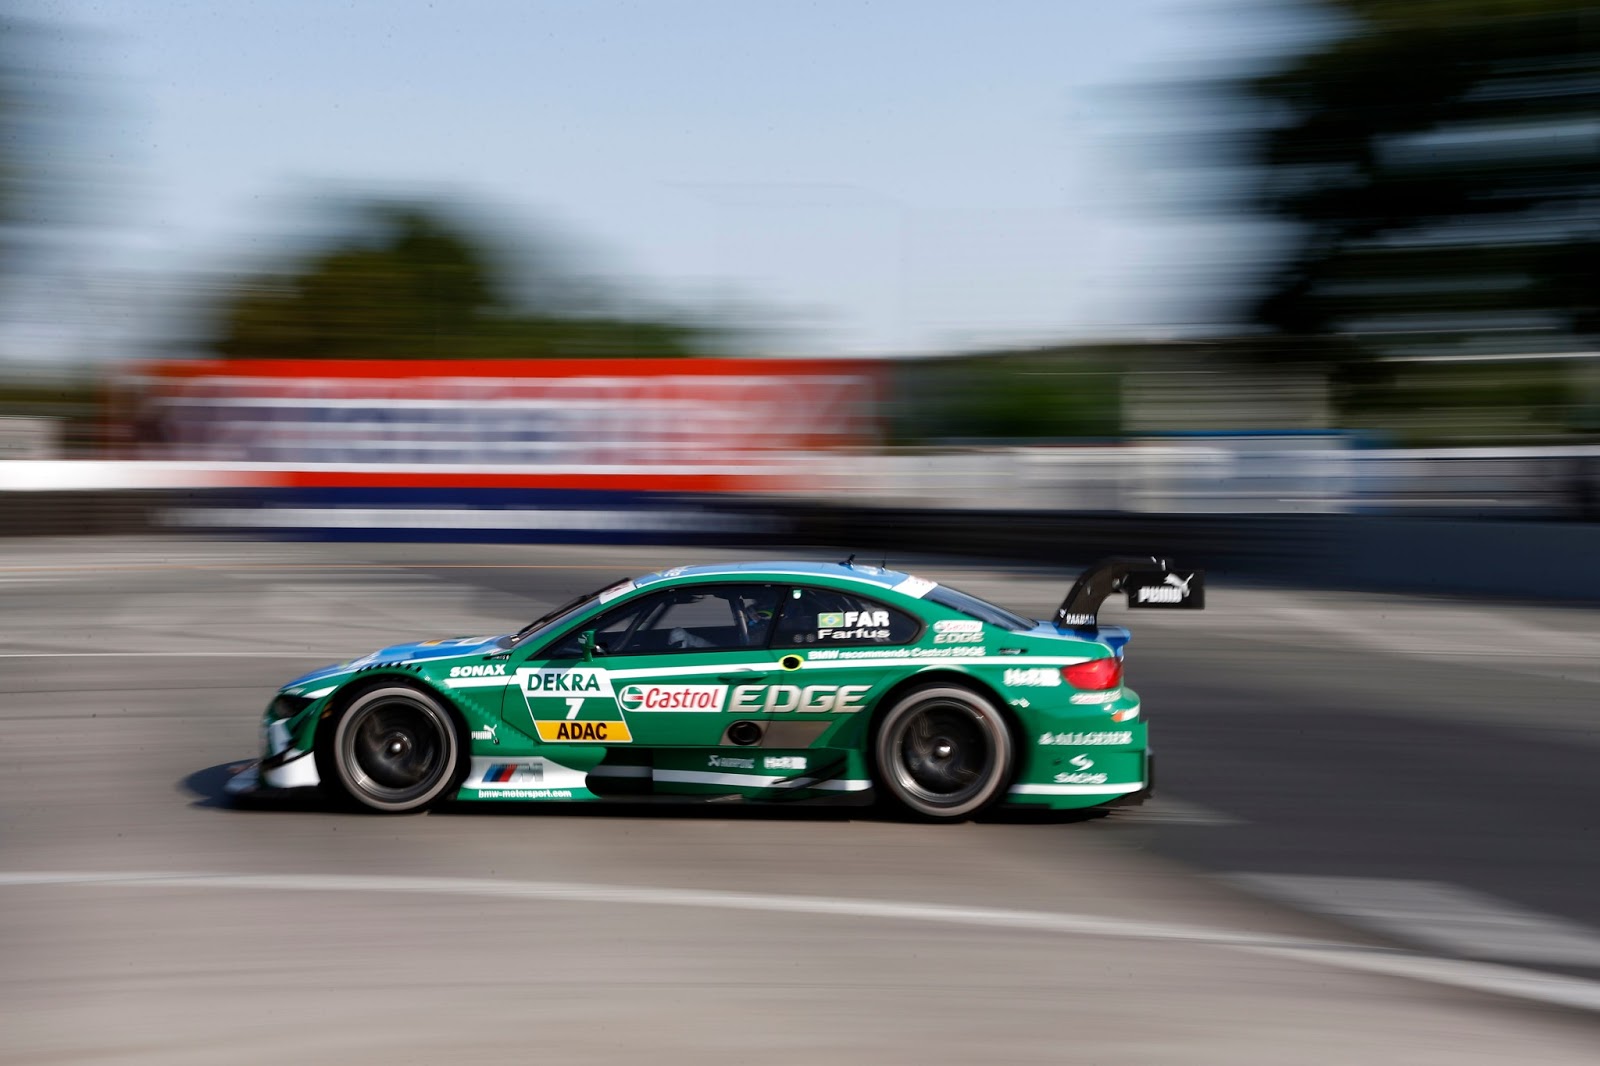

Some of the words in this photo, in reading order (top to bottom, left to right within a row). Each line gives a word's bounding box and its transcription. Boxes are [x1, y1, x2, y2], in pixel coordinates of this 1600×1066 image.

[844, 611, 890, 628] FAR
[818, 629, 890, 639] Farfus
[933, 632, 985, 643] EDGE
[450, 664, 506, 677] SONAX
[527, 673, 600, 691] DEKRA
[645, 687, 719, 708] Castrol
[727, 685, 873, 713] EDGE
[565, 698, 585, 720] 7
[557, 723, 607, 740] ADAC
[478, 788, 572, 798] bmw-motorsport.com
